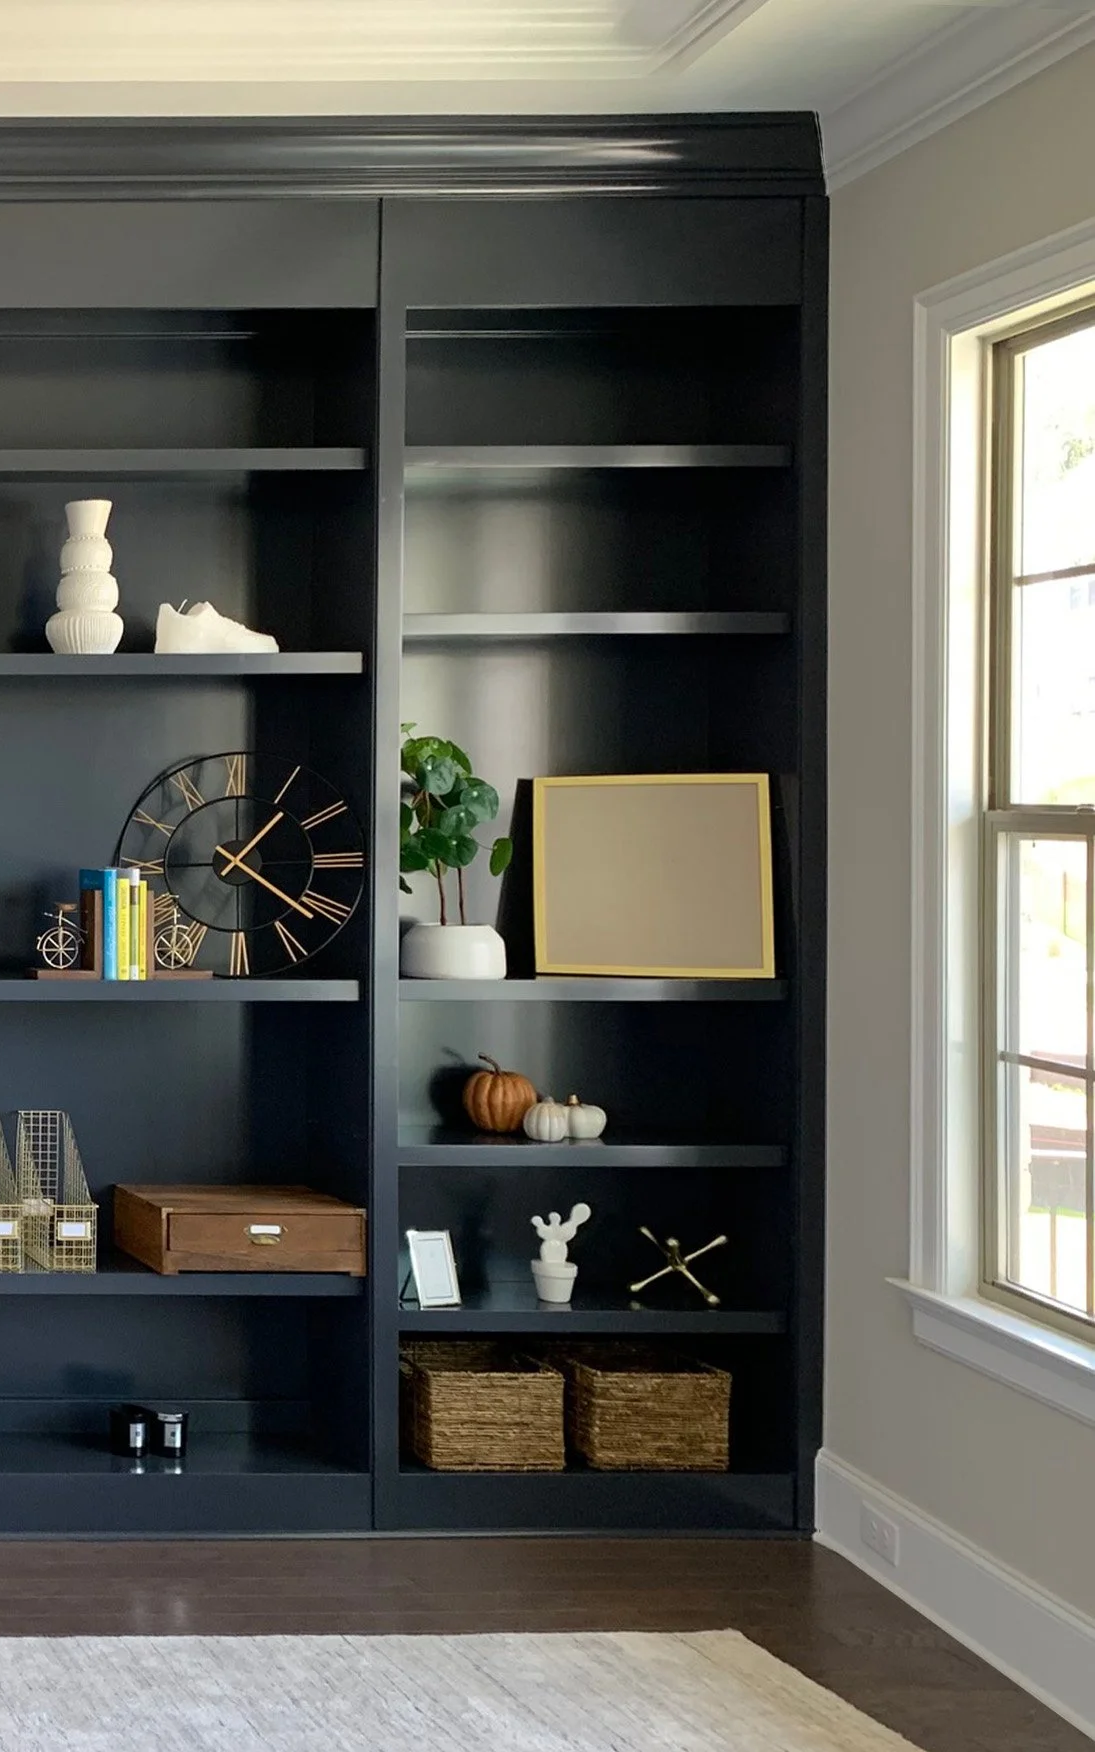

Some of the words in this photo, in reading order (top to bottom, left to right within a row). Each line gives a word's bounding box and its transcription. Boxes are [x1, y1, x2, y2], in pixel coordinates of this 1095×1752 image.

[225, 754, 246, 796] XII
[274, 765, 301, 804] I
[131, 808, 177, 837] X
[300, 800, 348, 830] II
[313, 852, 364, 869] III
